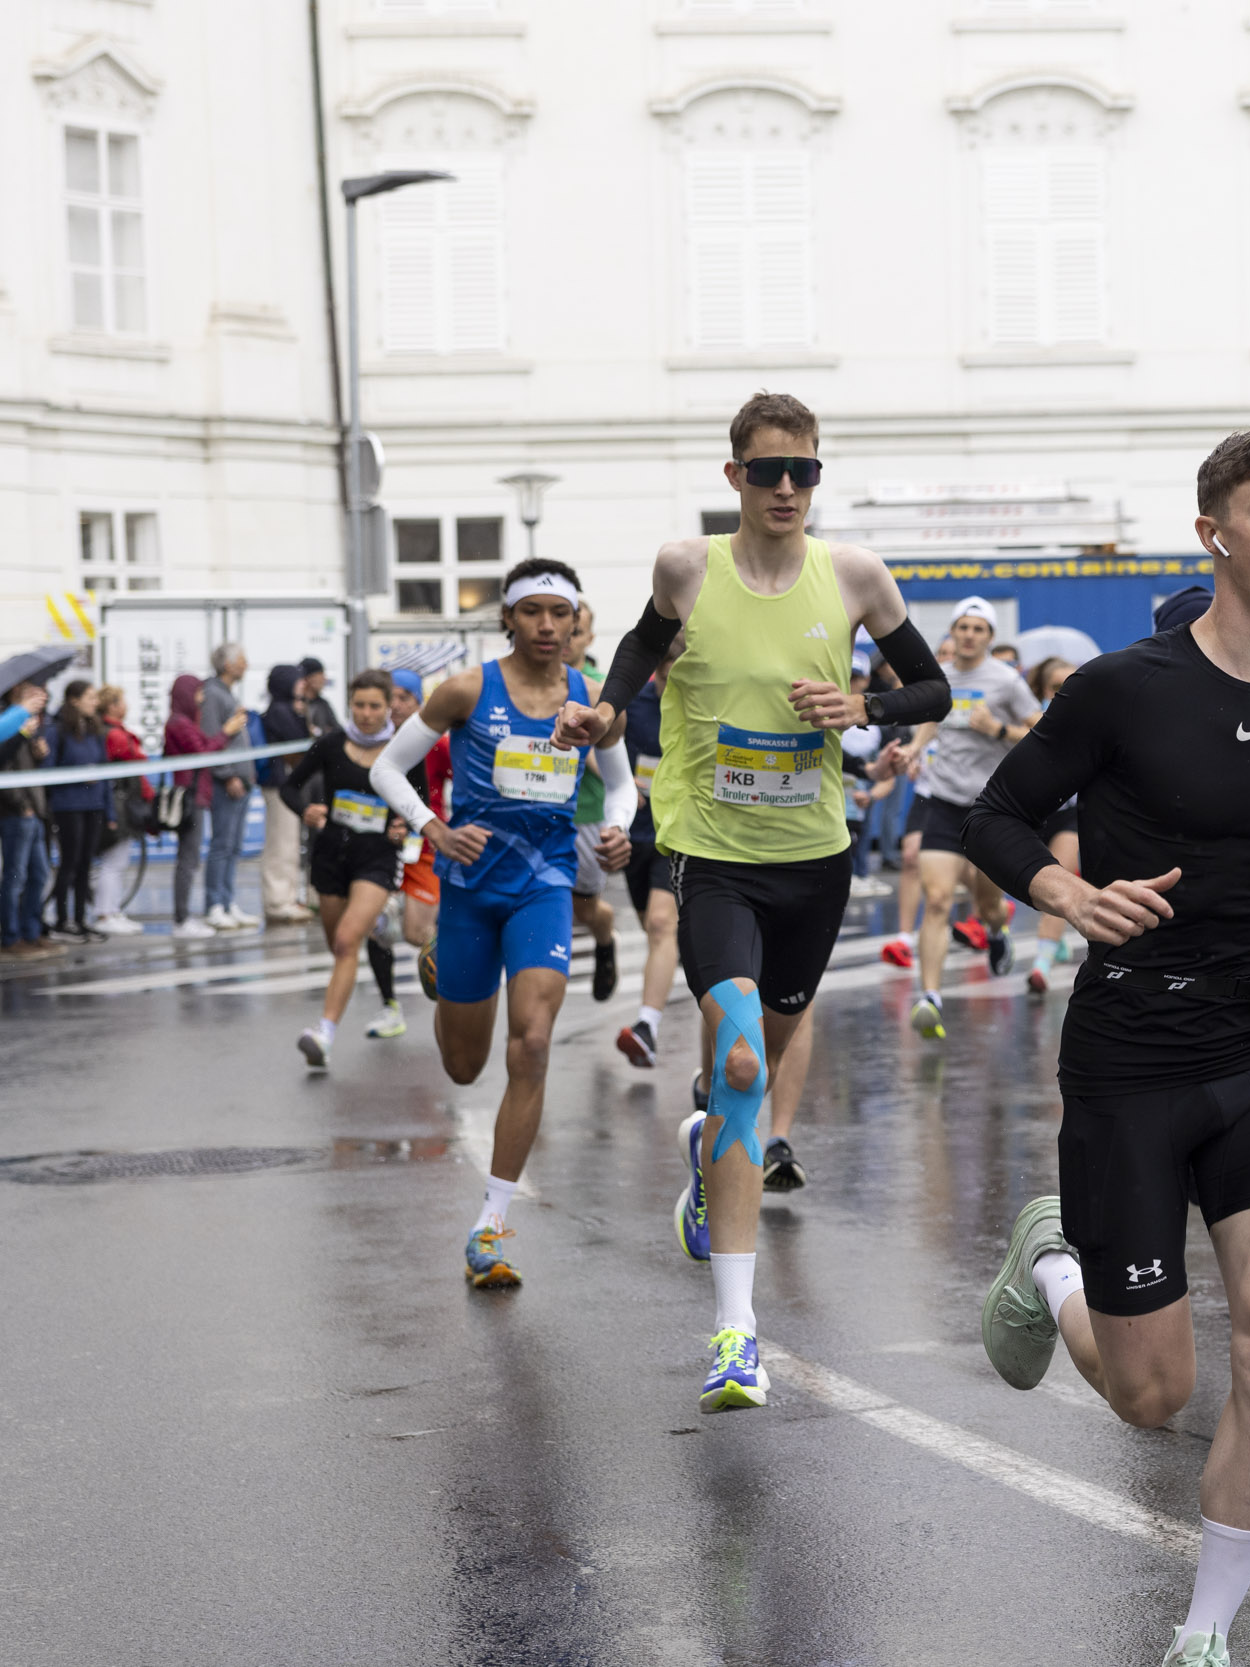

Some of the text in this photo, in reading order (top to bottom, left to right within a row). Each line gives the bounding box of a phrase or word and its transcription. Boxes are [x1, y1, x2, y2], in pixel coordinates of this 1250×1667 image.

[889, 560, 1214, 579] www.containex.c
[139, 635, 160, 751] OCHTIEF
[748, 738, 790, 748] SPARKASSE
[793, 750, 815, 764] tut
[795, 754, 822, 775] gut!
[782, 774, 790, 785] 2
[721, 786, 815, 804] Tiroler Tageszeitung
